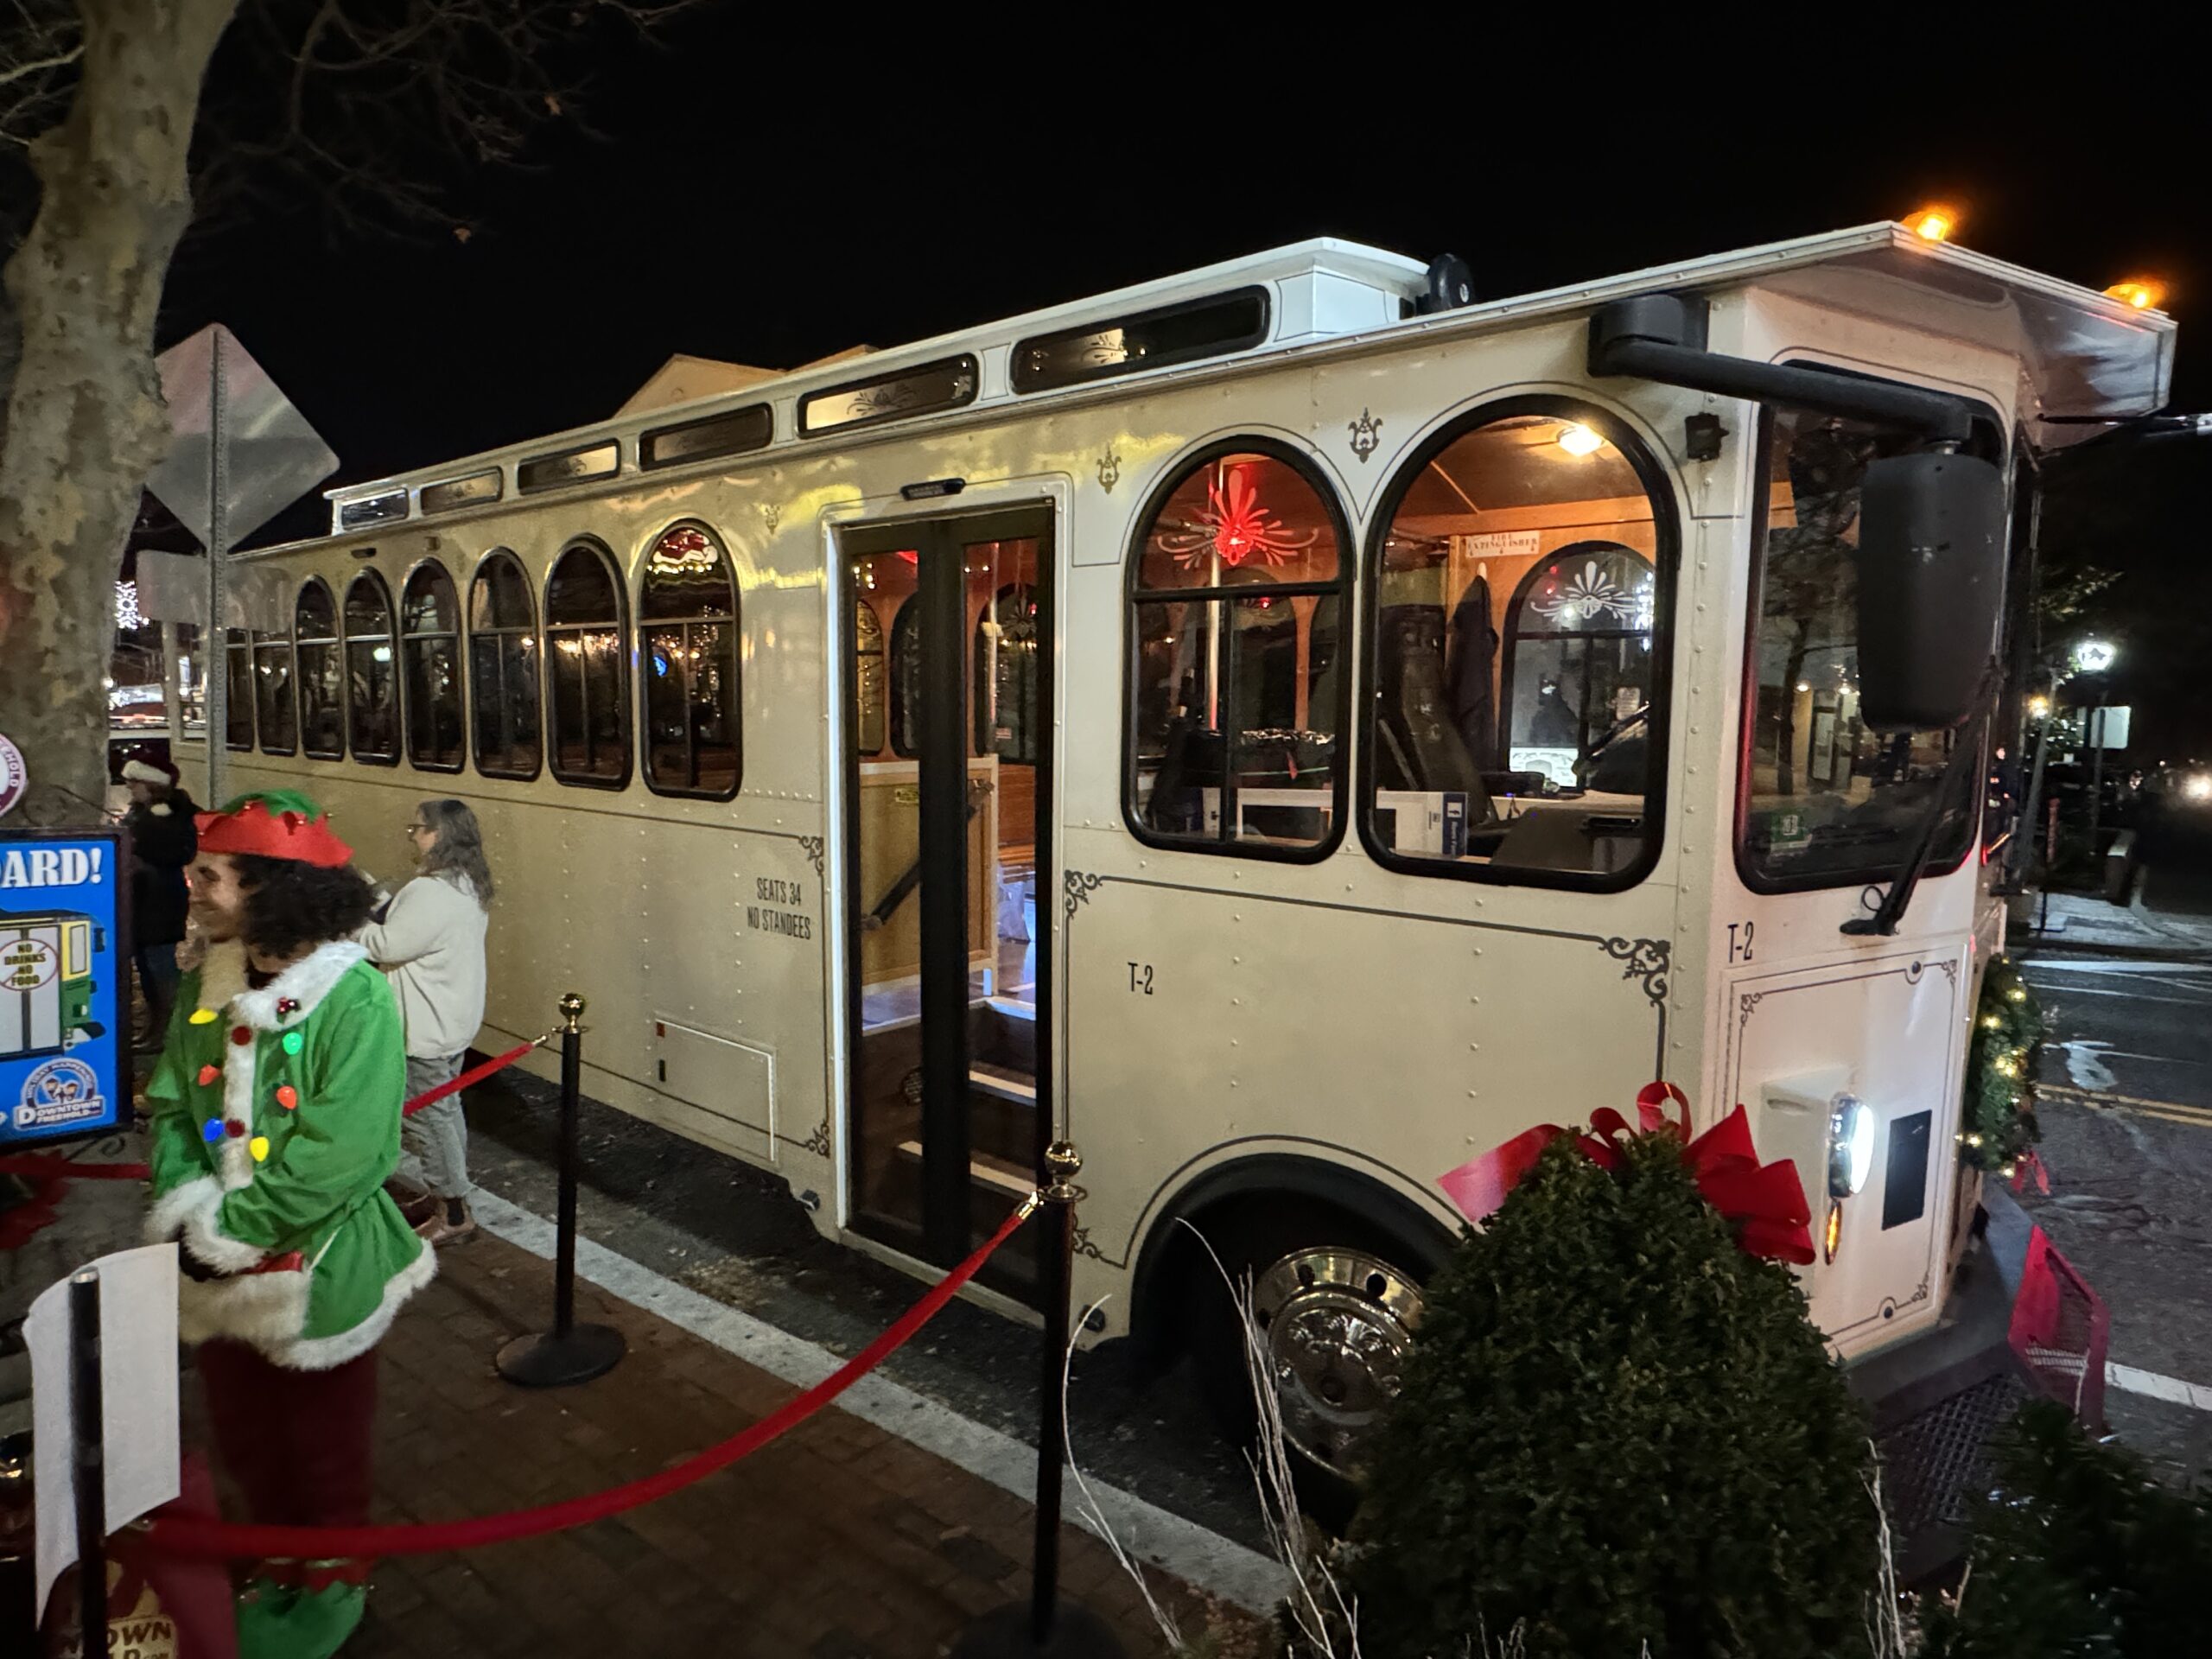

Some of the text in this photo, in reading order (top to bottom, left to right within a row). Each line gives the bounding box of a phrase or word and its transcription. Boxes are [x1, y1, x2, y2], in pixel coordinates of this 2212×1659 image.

[1, 848, 102, 888] ARD!
[757, 877, 801, 906] SEATS 34
[747, 906, 810, 940] NO STANDEES
[18, 944, 32, 953] NO
[1728, 921, 1754, 963] T-2
[4, 953, 46, 965] DRINKS
[18, 964, 33, 975] NO
[11, 975, 40, 986] FOOD
[1128, 961, 1153, 995] T-2
